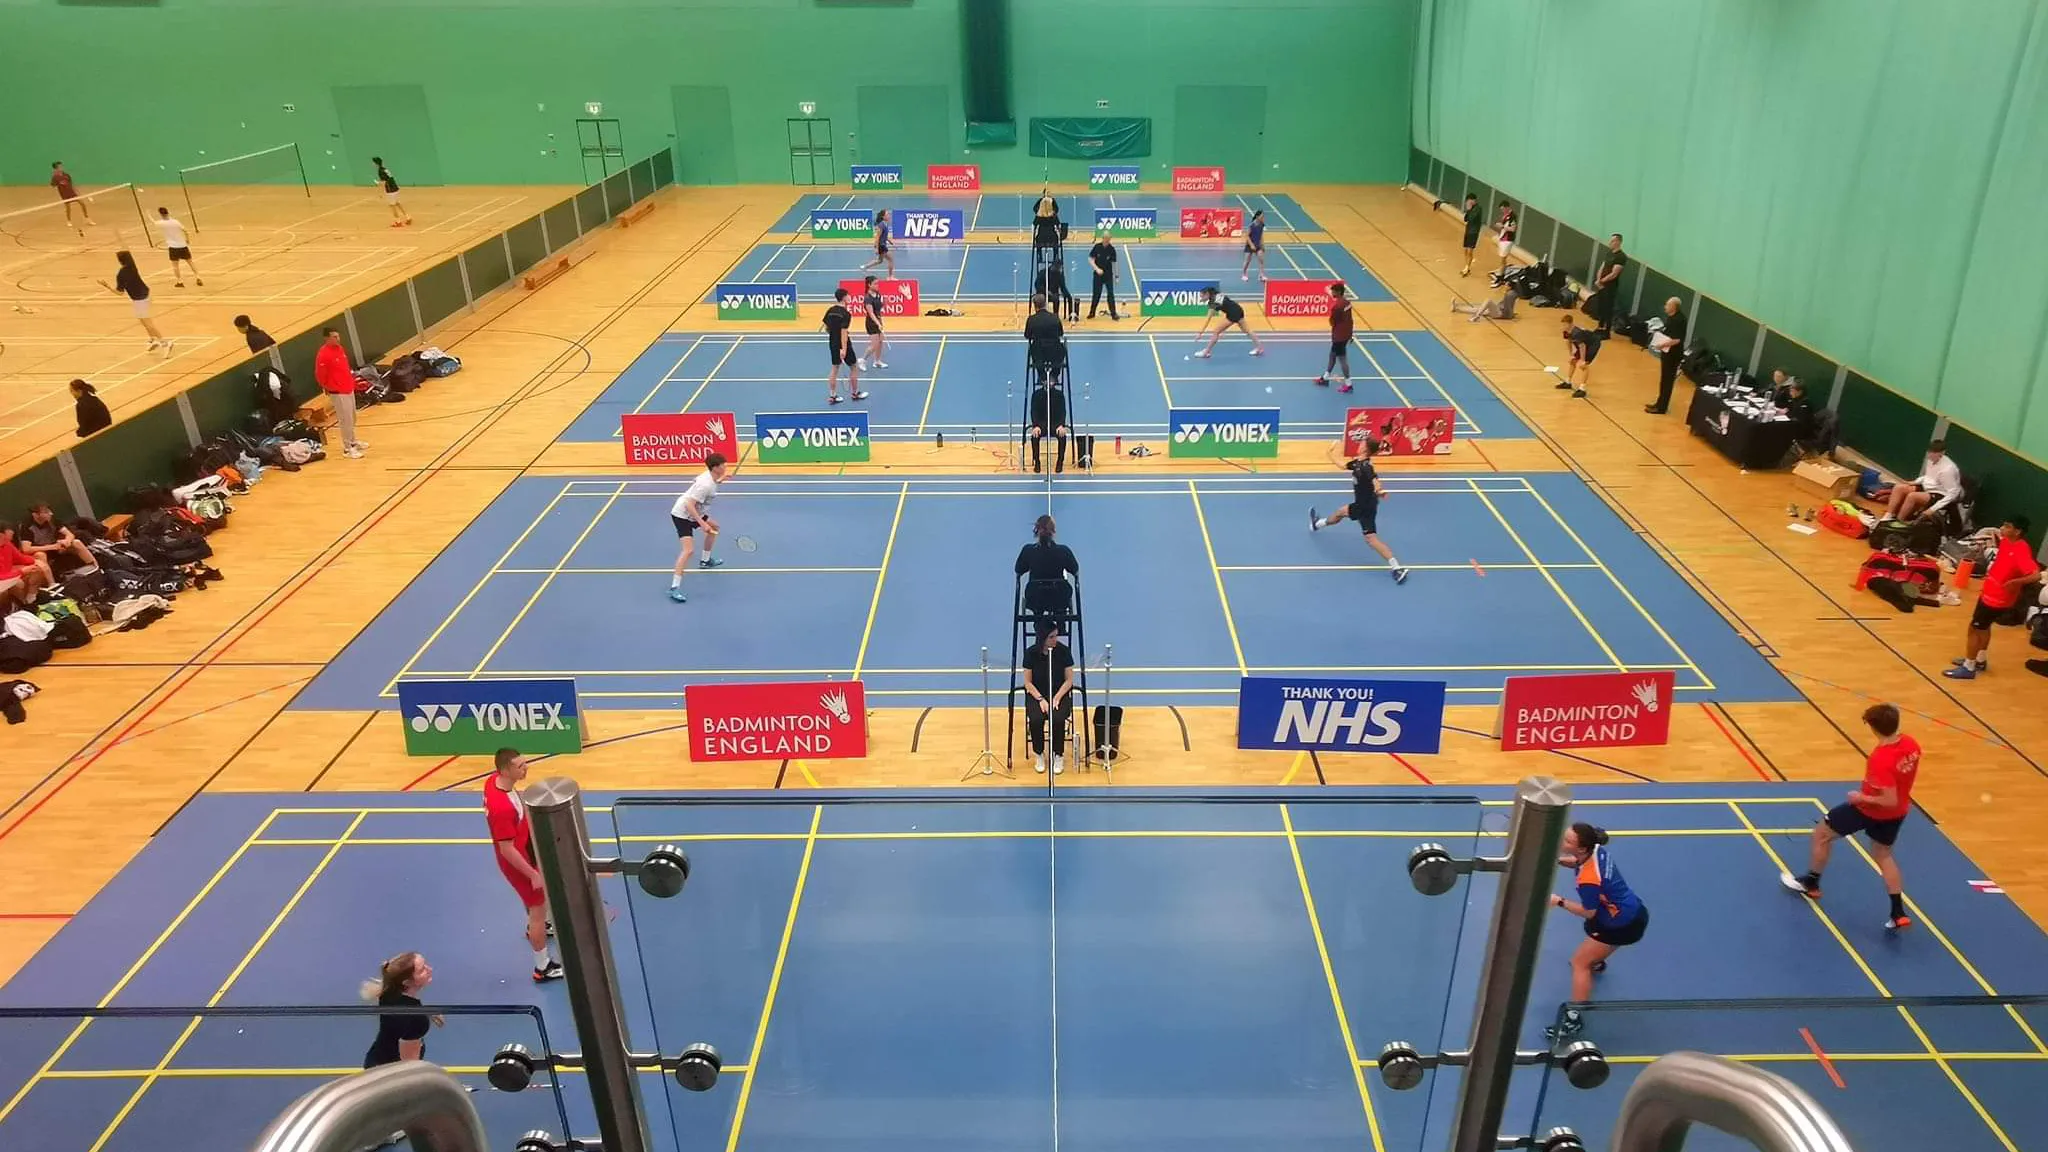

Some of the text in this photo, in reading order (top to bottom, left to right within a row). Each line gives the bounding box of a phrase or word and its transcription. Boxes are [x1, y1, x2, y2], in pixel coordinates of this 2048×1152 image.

[871, 173, 899, 183] YONEX
[931, 181, 969, 189] ENGLAND
[1108, 173, 1137, 184] YONEX
[1176, 183, 1214, 191] ENGLAND
[835, 218, 869, 230] YONEX
[904, 218, 951, 237] NHS
[1119, 217, 1152, 230] YONEX
[747, 294, 791, 309] YONEX
[1271, 295, 1329, 304] BADMINTON
[1271, 304, 1328, 314] ENGLAND
[799, 427, 861, 447] YONEX
[1212, 423, 1271, 443] YONEX
[632, 434, 714, 447] BADMINTON
[1281, 687, 1374, 701] THANK YOU!
[467, 702, 567, 732] YONEX
[1517, 704, 1639, 724] BADMINTON
[703, 714, 832, 734] BADMINTON
[1273, 700, 1407, 746] NHS
[1515, 722, 1636, 745] ENGLAND
[704, 733, 832, 756] ENGLAND
